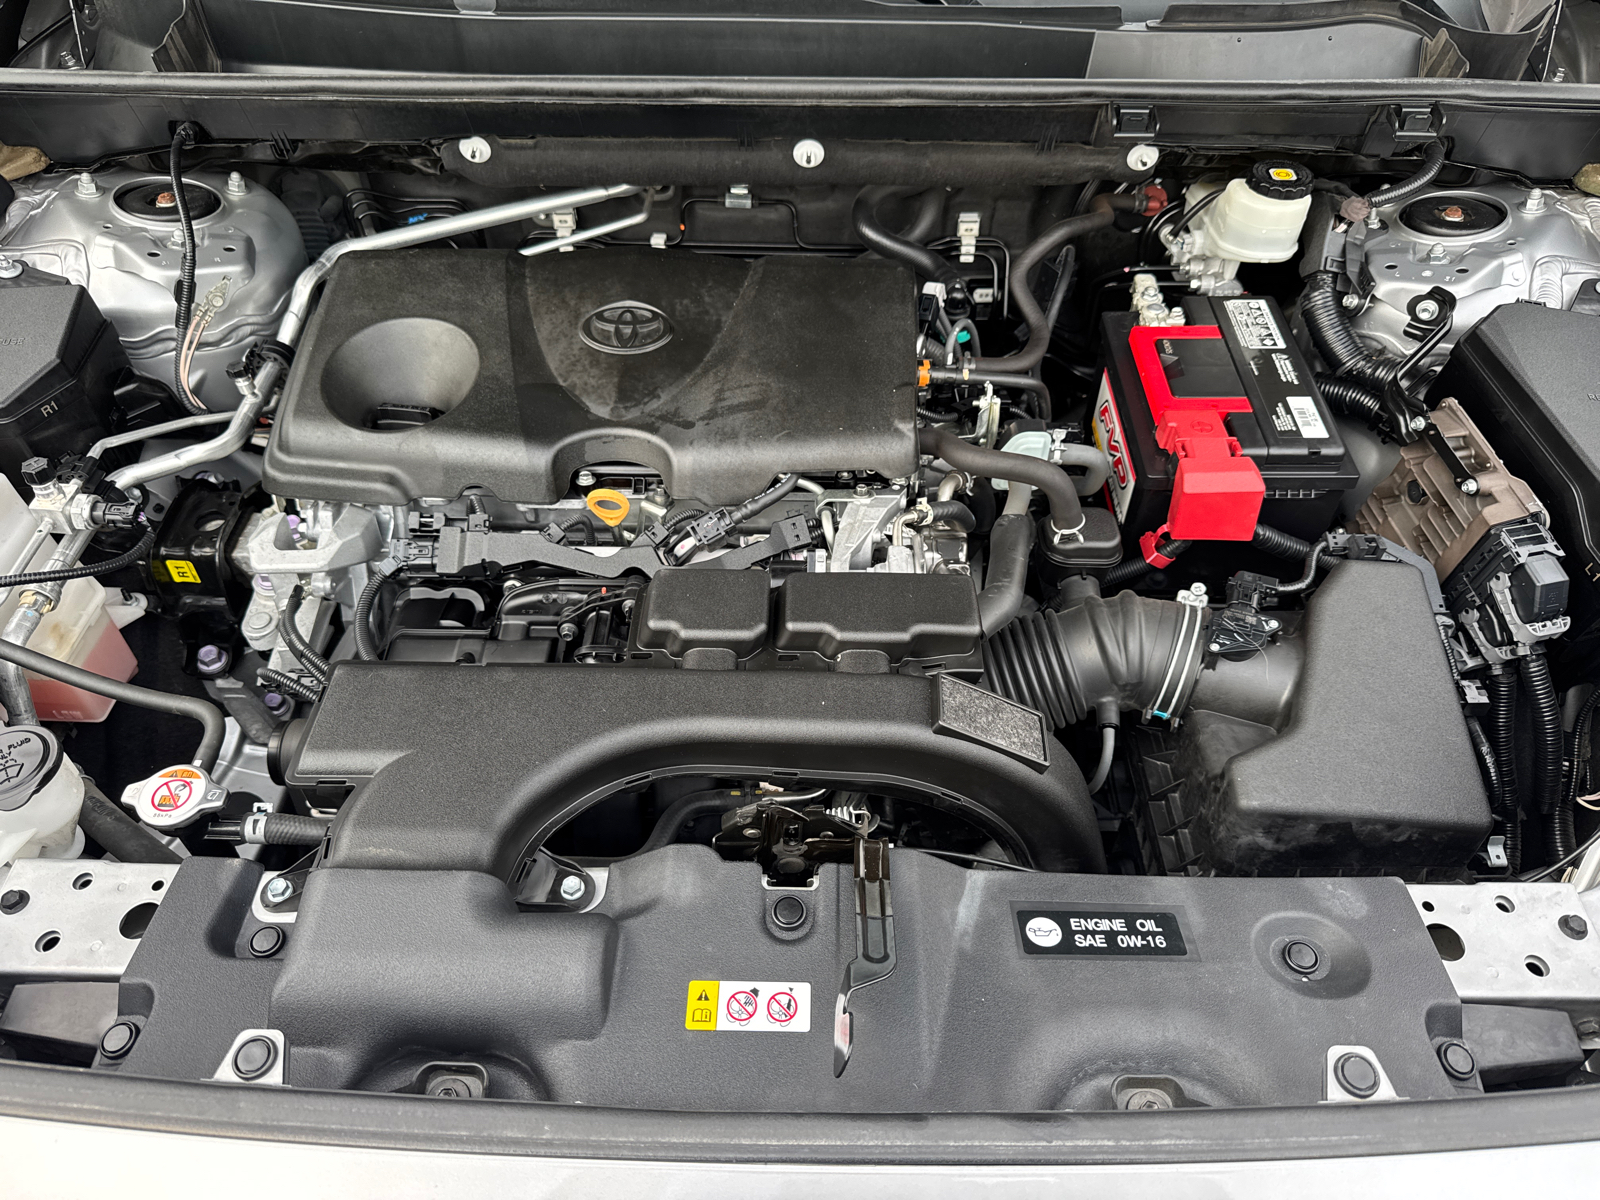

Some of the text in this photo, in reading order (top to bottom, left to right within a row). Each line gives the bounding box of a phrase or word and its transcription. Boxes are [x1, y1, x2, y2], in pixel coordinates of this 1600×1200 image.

[0, 337, 25, 346] USE
[40, 400, 59, 417] R1
[1099, 400, 1129, 490] FVP
[174, 565, 190, 578] R1
[7, 737, 31, 750] FLUID
[1069, 918, 1164, 932] ENGINE OIL
[1074, 934, 1167, 948] SAE 0W-16
